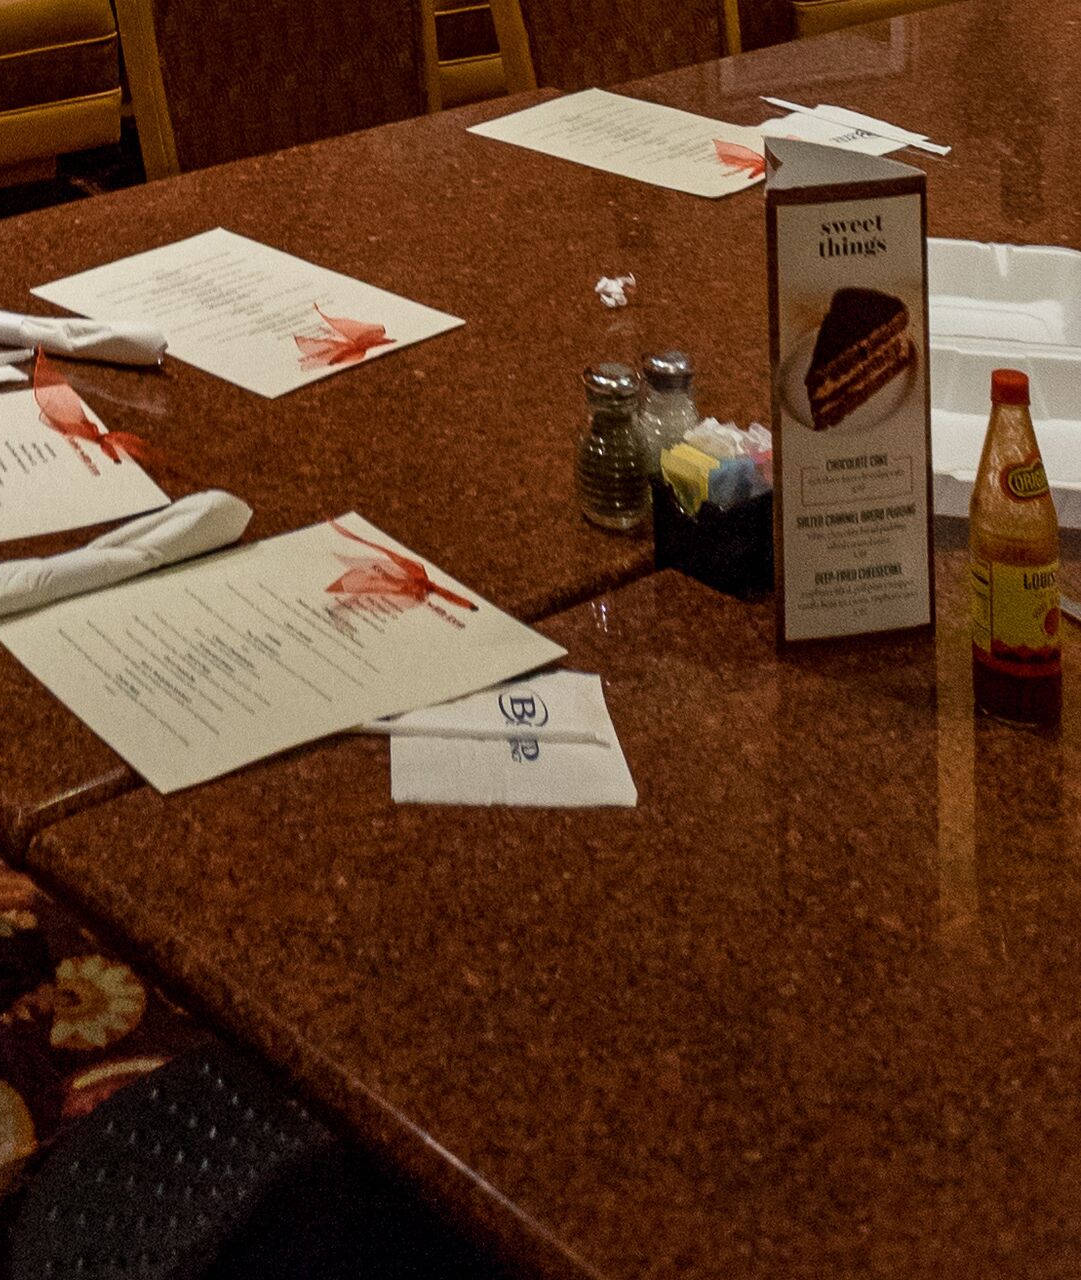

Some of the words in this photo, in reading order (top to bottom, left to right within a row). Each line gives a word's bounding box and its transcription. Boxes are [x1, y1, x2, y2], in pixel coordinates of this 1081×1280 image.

[821, 215, 883, 235] sweet
[818, 236, 888, 258] things
[826, 455, 868, 472] CHOCOLATE
[509, 695, 540, 762] BD
